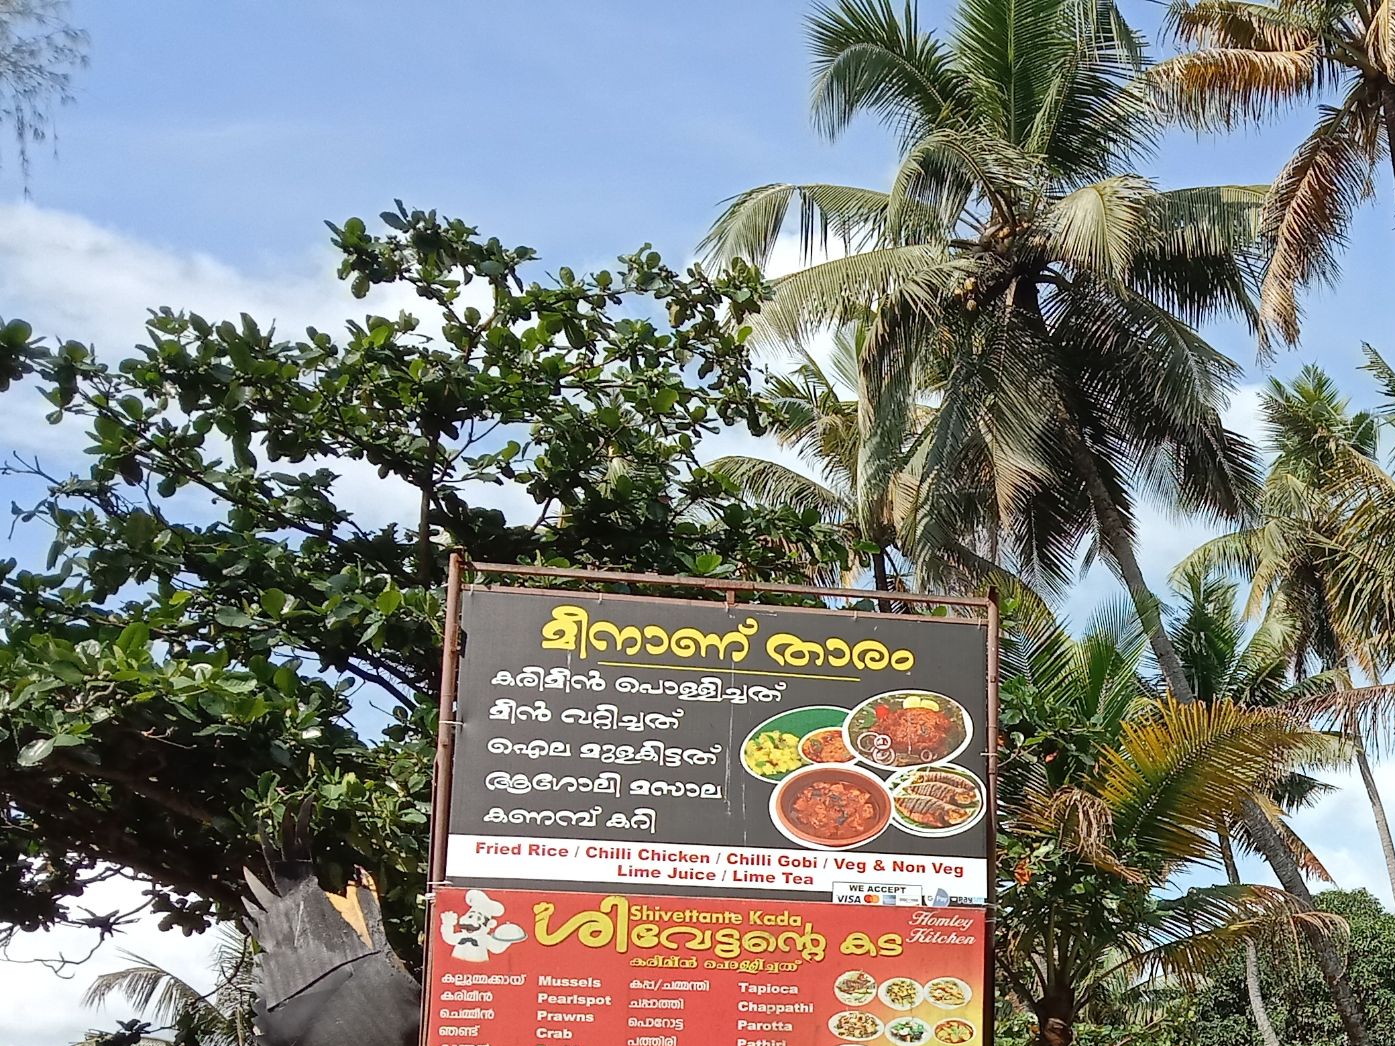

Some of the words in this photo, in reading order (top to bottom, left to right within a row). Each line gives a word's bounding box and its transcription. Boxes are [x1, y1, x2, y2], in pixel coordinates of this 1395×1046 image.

[541, 605, 758, 663] മീനാണ്
[766, 633, 914, 671] താരം
[491, 666, 606, 692] കരിമീൻ
[615, 676, 786, 704] പൊള്ളിച്ചത്
[489, 699, 551, 724] മീൻ
[561, 704, 684, 731] വറ്റിച്ചത്
[487, 737, 571, 758] ഐല
[580, 740, 721, 766] മുളകിട്ടത്
[630, 780, 722, 799] മസാല
[606, 808, 656, 833] കറി
[476, 842, 521, 856] Fried
[528, 844, 568, 857] Rice
[586, 846, 631, 860] Chilli
[638, 849, 710, 864] Chicken
[727, 853, 771, 866] Chilli
[778, 855, 817, 869] Gobi
[834, 858, 866, 873] Veg
[873, 859, 886, 871] &
[892, 861, 925, 873] Non
[932, 862, 964, 877] Veg
[618, 865, 661, 878] Lime
[667, 868, 716, 880] Juice
[733, 870, 775, 883] Lime
[782, 872, 813, 885] Tea
[838, 895, 861, 903] VISA
[630, 906, 742, 925] Shivettante
[750, 909, 801, 926] Kada
[909, 911, 974, 931] Homley
[906, 927, 976, 945] Kitchen
[840, 933, 903, 957] കട
[629, 955, 697, 969] കരിമീൻ
[538, 976, 601, 988] Mussels
[738, 982, 798, 995] Tapioca
[441, 990, 493, 1002] കരിമീൻ
[537, 993, 611, 1006] Pearlspot
[439, 1008, 494, 1020] ചെമ്മീൻ
[738, 1001, 814, 1014] Chappathi
[537, 1011, 594, 1022] Prawns
[536, 1028, 572, 1039] Crab
[737, 1020, 793, 1032] Parotta
[627, 1036, 677, 1046] പത്തിരി
